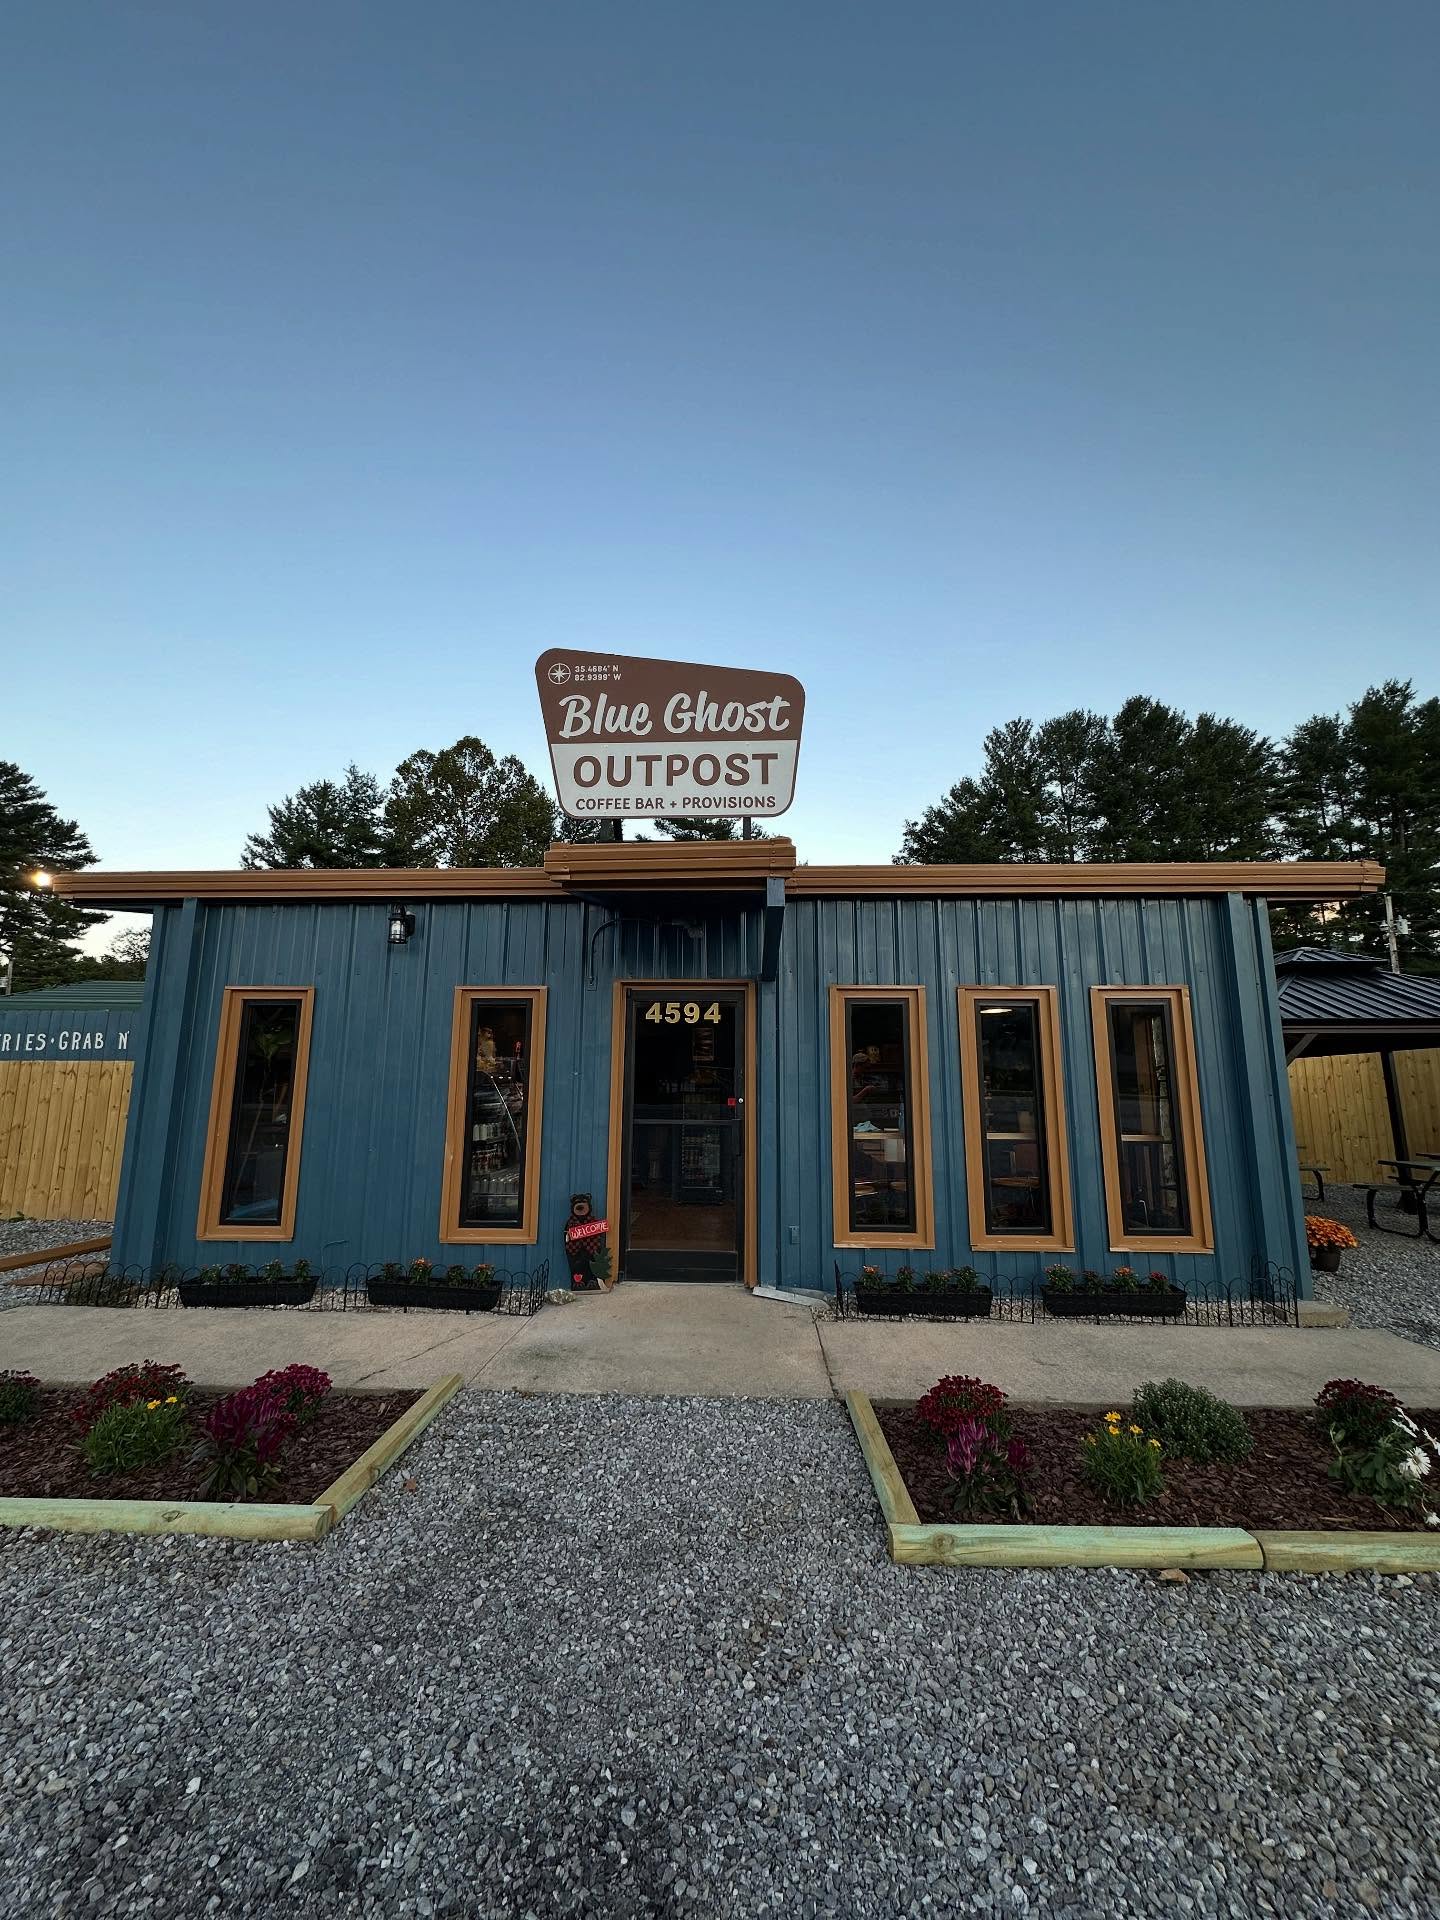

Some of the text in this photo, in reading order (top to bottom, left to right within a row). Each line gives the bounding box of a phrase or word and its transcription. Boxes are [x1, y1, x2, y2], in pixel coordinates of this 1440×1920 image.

[612, 664, 619, 672] N
[613, 673, 622, 681] W
[558, 690, 791, 739] Blue Ghost
[573, 753, 779, 788] OUTPOST
[575, 797, 631, 811] COFFEE
[635, 797, 665, 810] BAR
[682, 796, 776, 809] PROVISIONS
[645, 1002, 722, 1024] 4594
[570, 1220, 610, 1240] WELCOME
